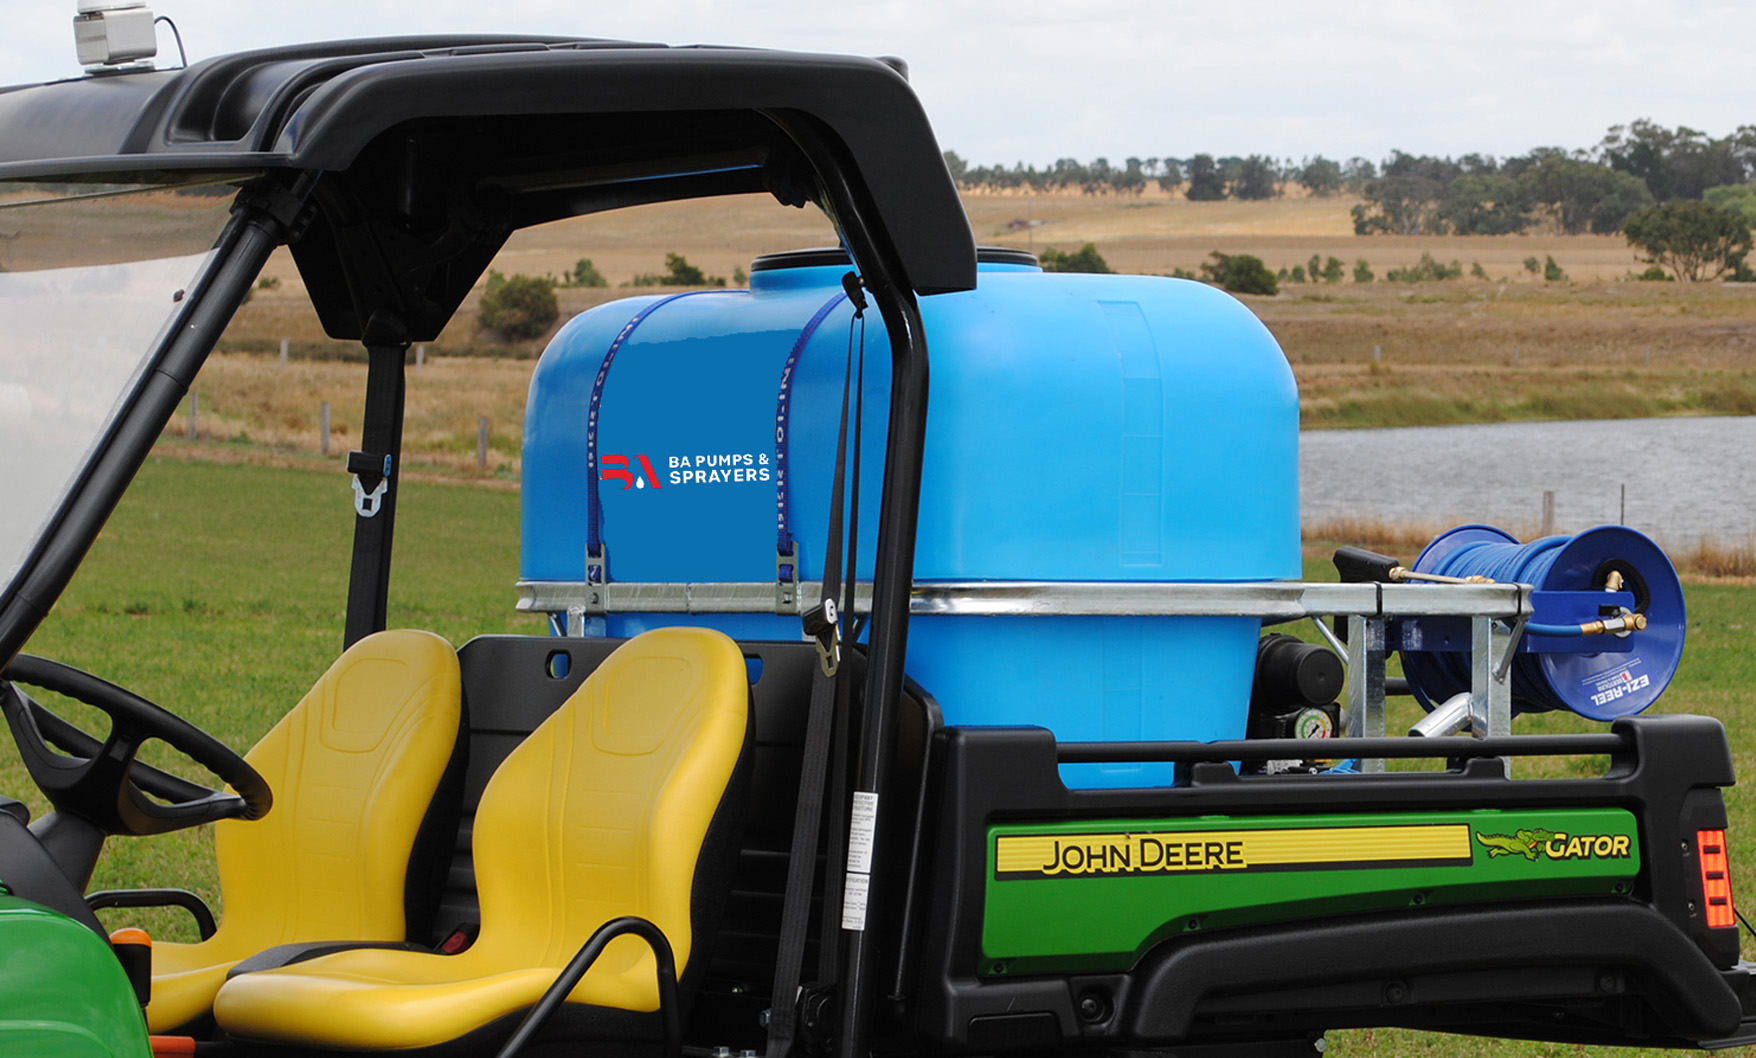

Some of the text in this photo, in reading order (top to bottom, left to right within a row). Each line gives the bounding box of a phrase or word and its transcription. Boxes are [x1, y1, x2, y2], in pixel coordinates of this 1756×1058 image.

[669, 453, 769, 468] BA PUMPS &
[669, 468, 770, 484] SPRAYERS
[1591, 674, 1649, 705] EZI-REEL
[1042, 838, 1245, 871] JOHN DEERE
[1545, 832, 1631, 859] GATOR
